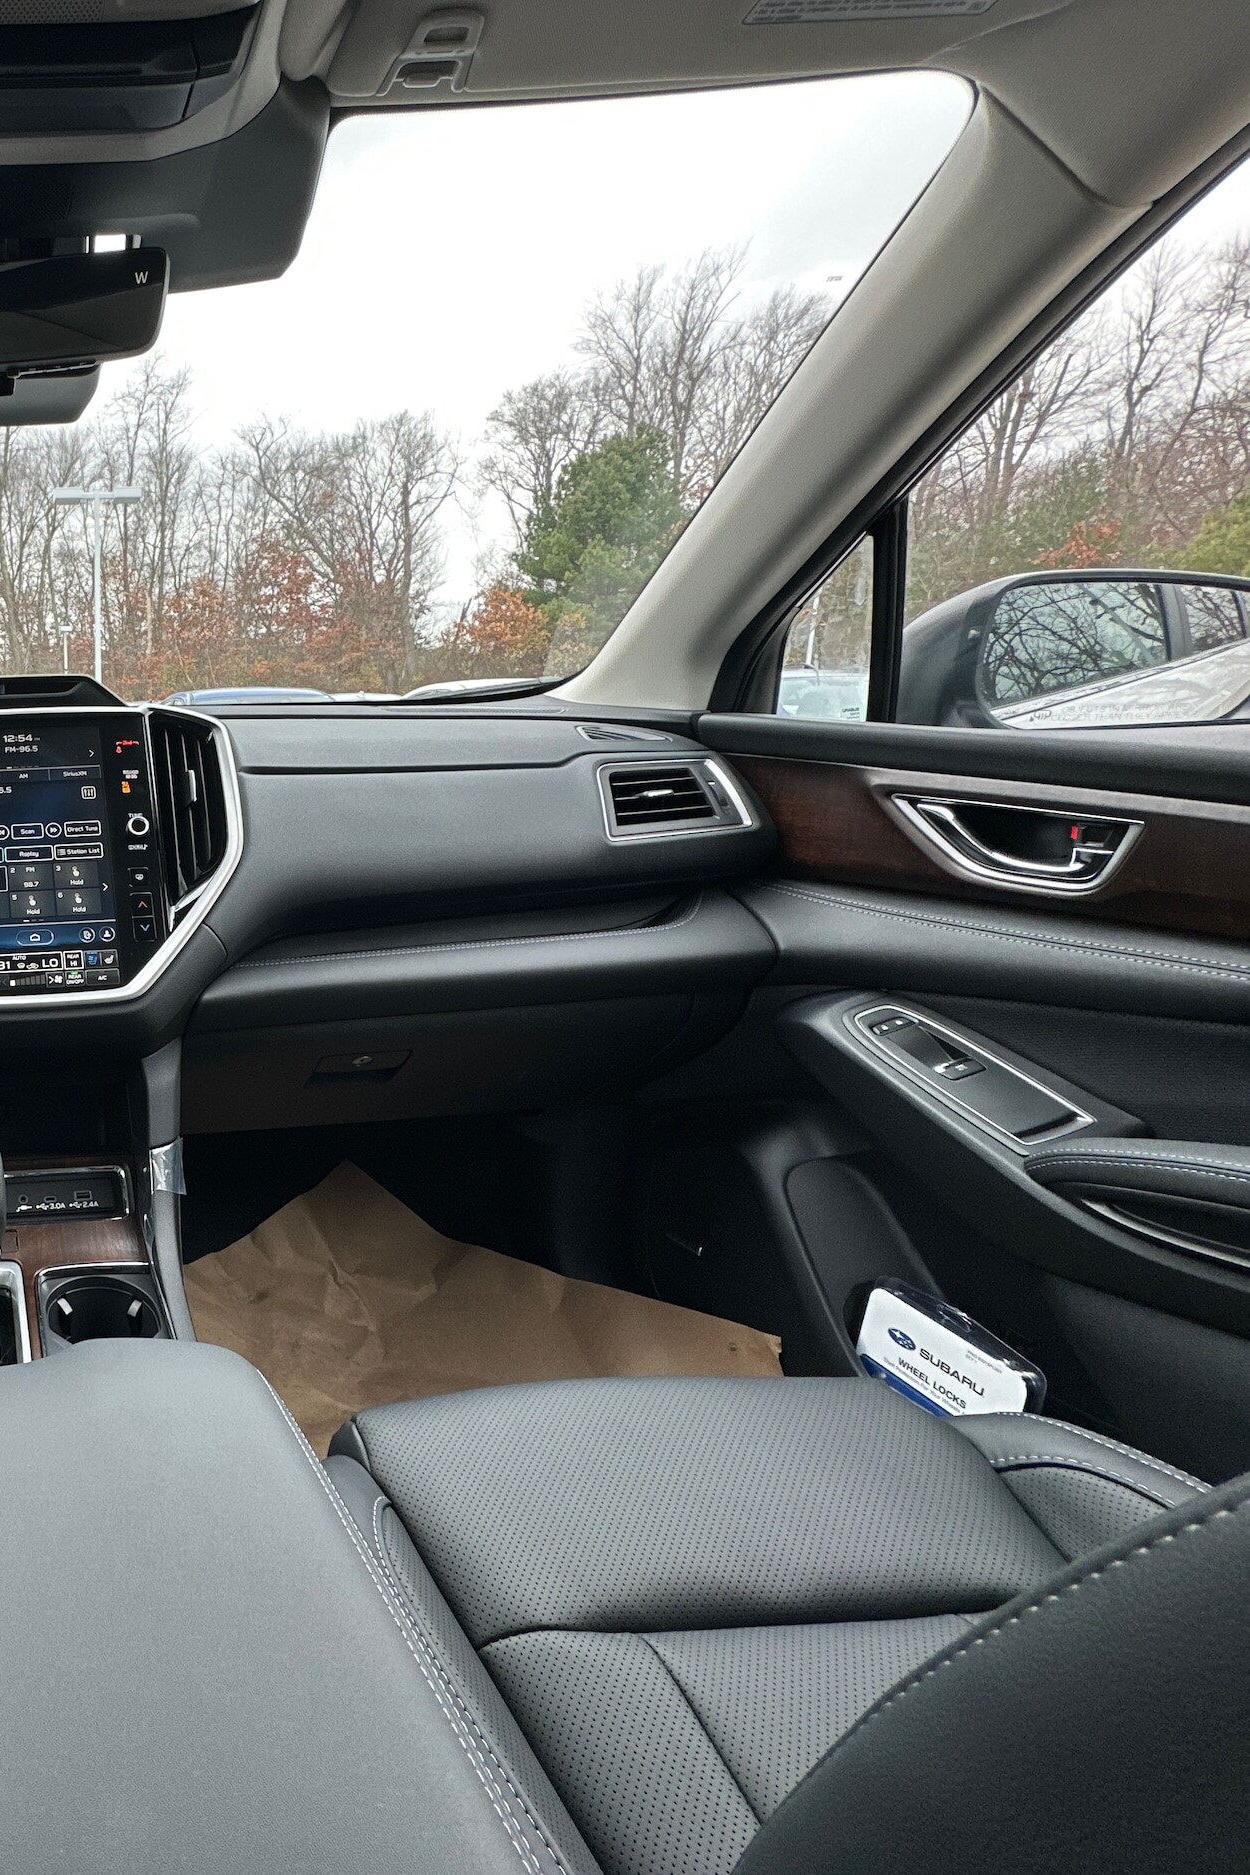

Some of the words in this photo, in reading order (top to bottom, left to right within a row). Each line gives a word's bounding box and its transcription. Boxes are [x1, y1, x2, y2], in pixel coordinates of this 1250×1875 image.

[134, 271, 148, 284] W
[2, 734, 33, 743] 12:54
[42, 958, 58, 968] LO
[919, 1348, 985, 1396] SUBARU
[898, 1357, 930, 1386] WHEEL
[933, 1381, 966, 1409] LOCKS
